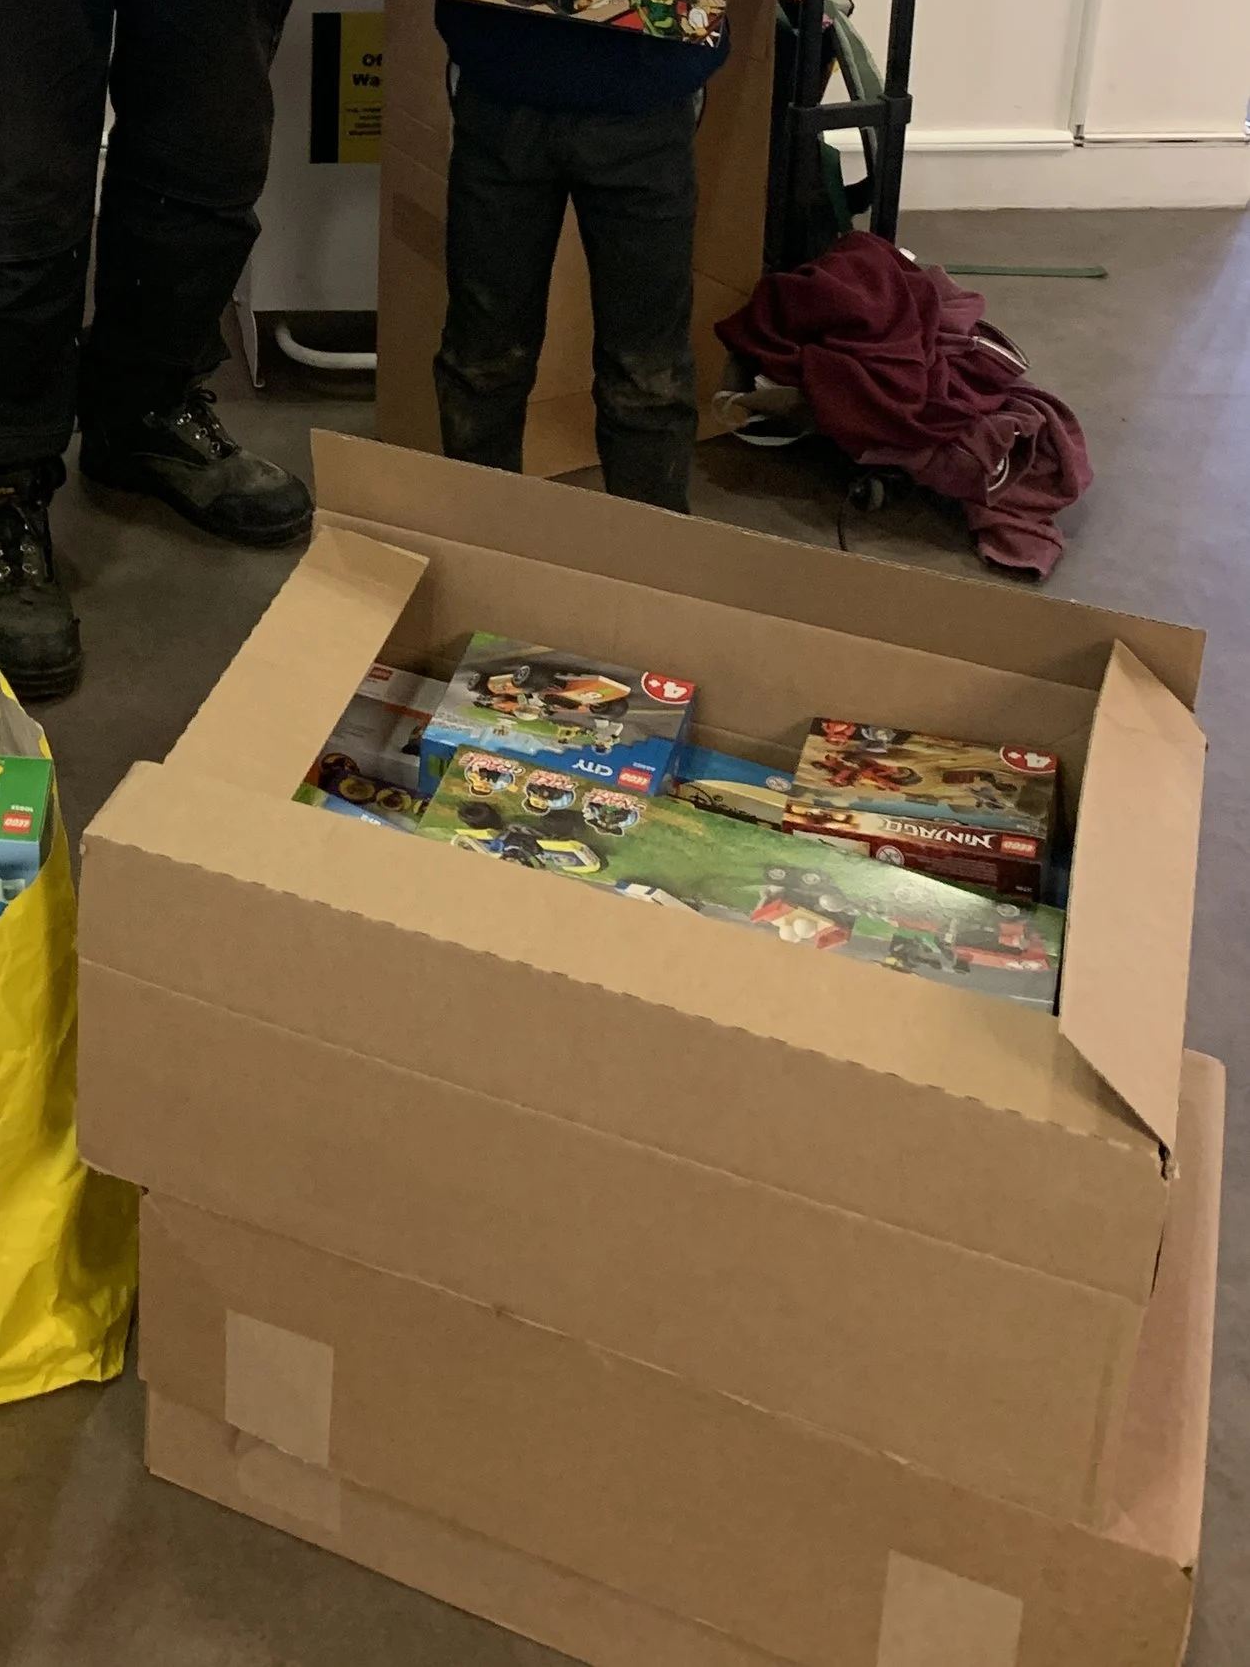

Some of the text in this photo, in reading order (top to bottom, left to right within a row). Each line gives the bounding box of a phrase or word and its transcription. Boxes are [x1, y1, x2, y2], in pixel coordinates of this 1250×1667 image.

[647, 678, 688, 699] 4+
[571, 758, 614, 777] CITY
[1007, 750, 1052, 768] 4+
[882, 818, 998, 850] NINJAGO
